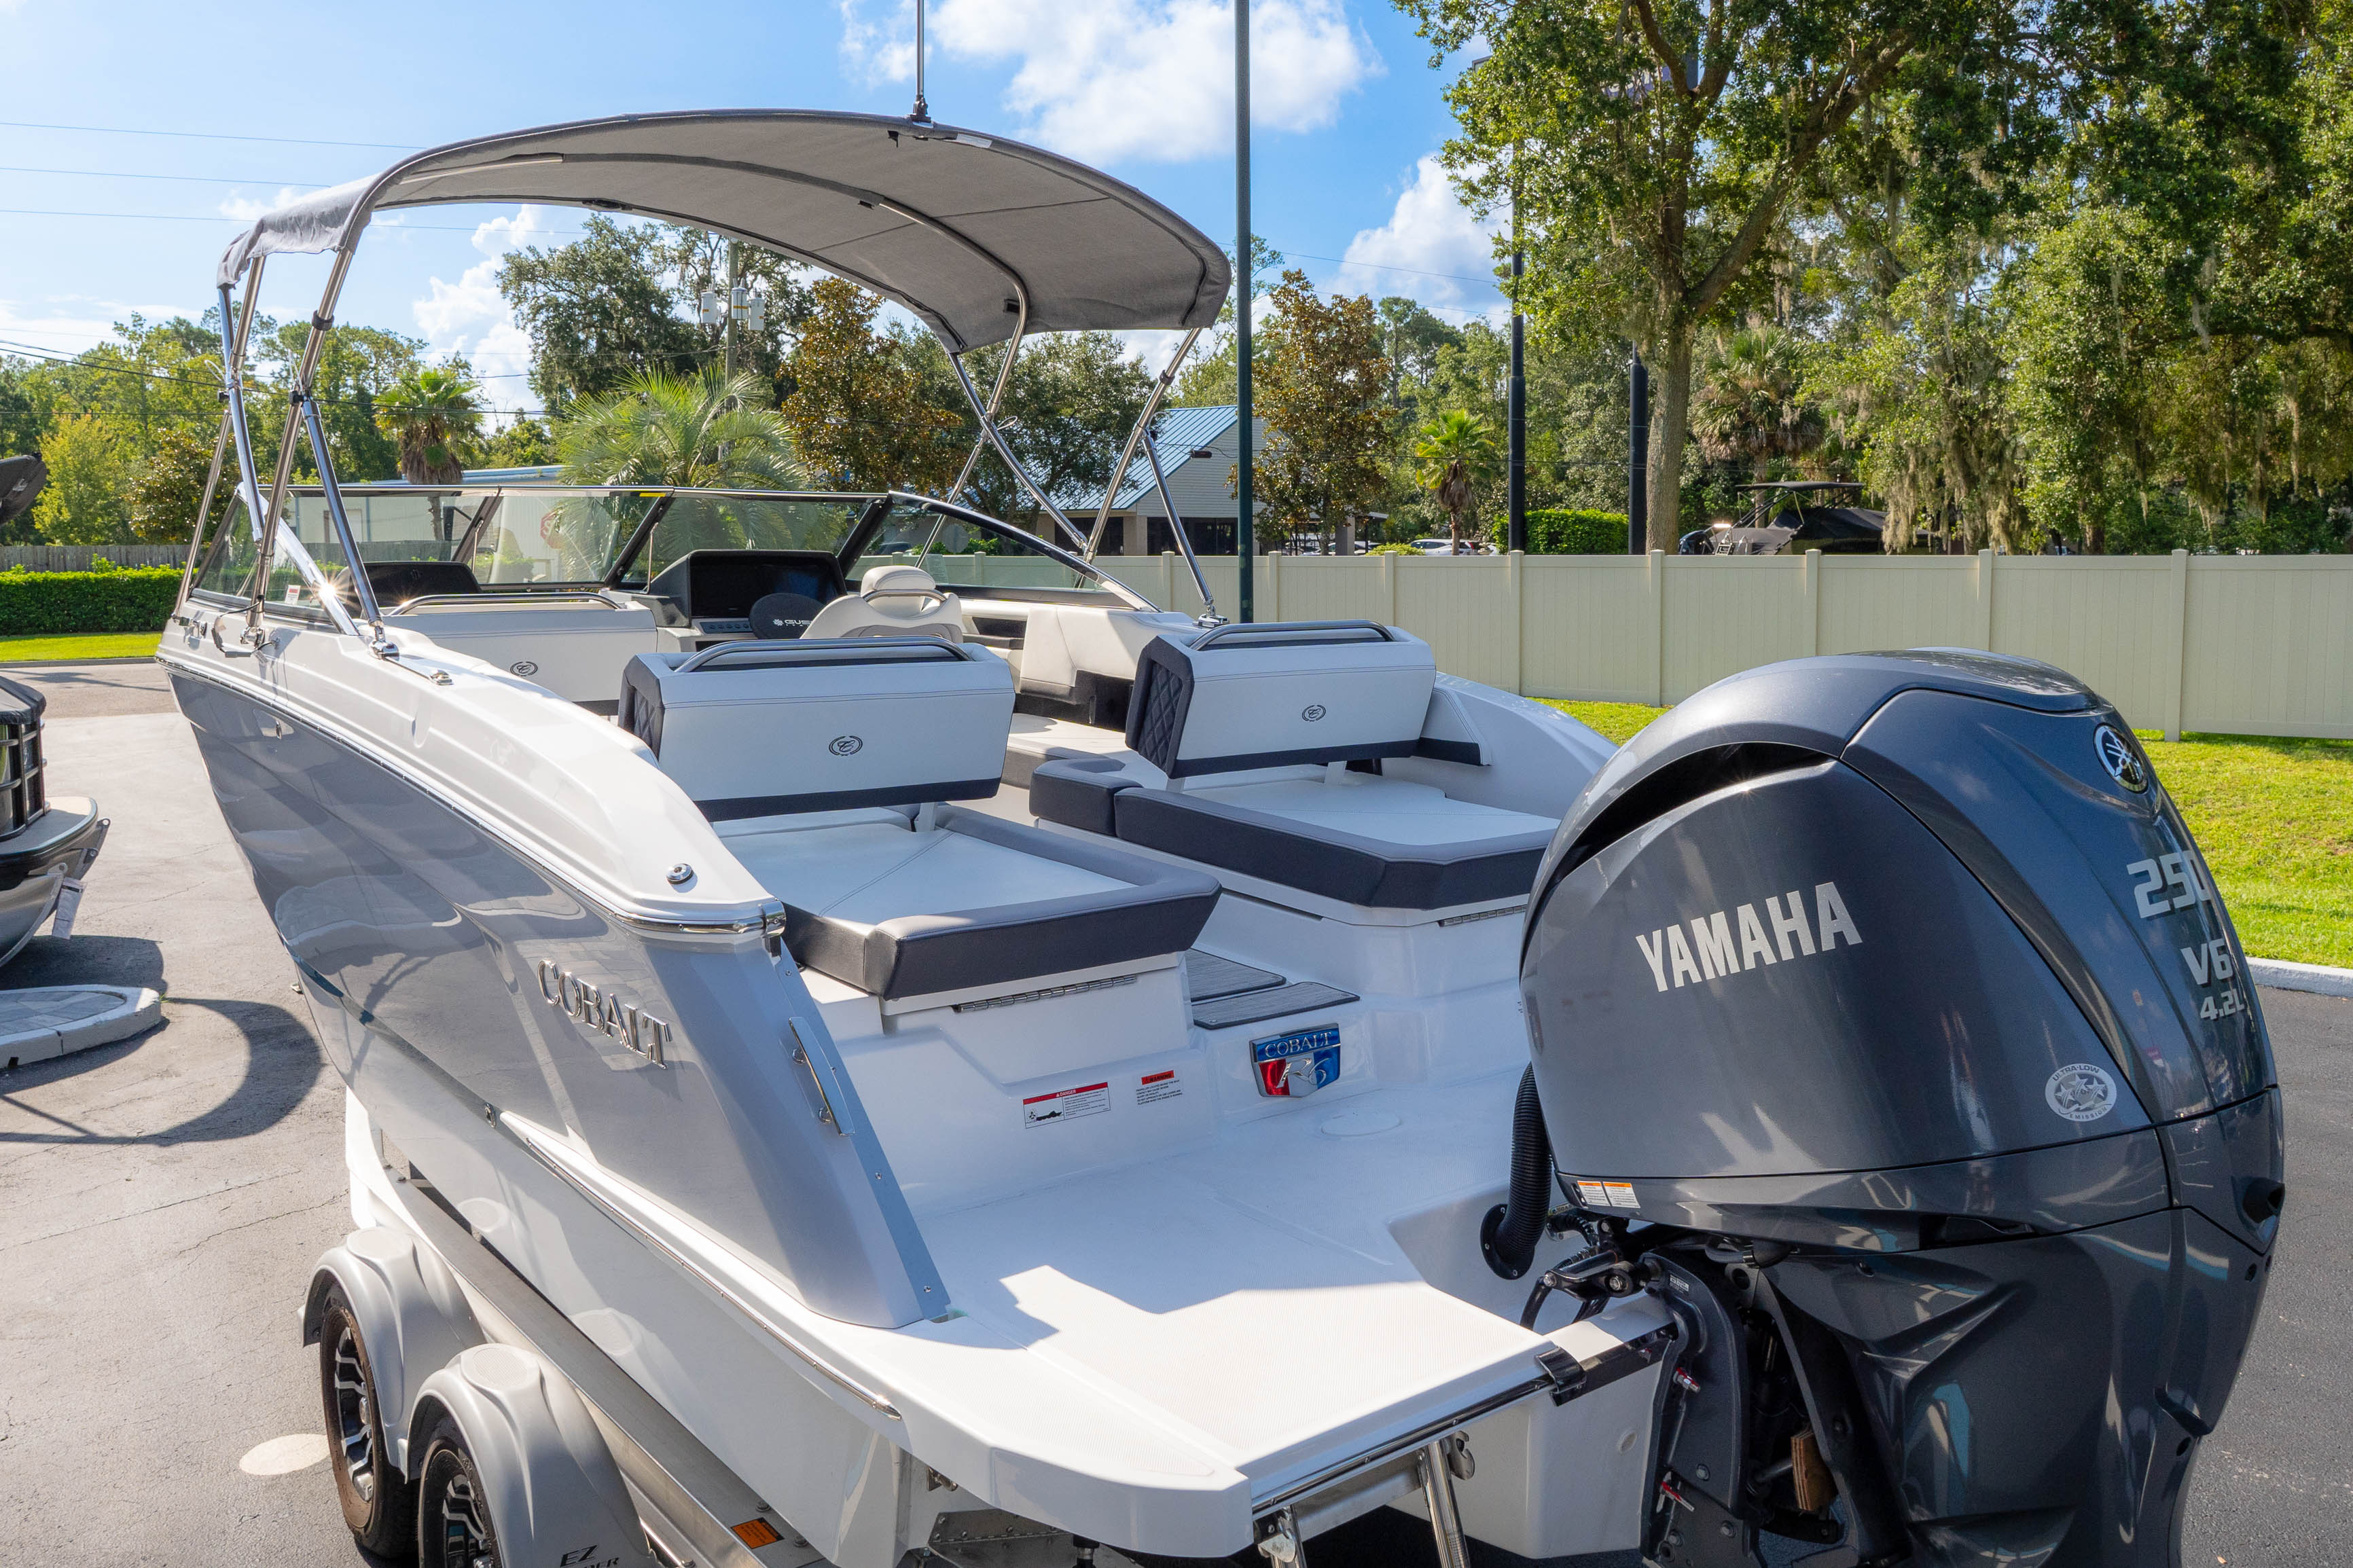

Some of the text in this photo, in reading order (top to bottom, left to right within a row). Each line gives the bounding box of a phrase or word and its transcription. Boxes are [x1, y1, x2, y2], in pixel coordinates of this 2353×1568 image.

[1635, 881, 1863, 992] YAMAHA
[2180, 938, 2233, 985] V6
[537, 960, 672, 1070] COBALT
[2200, 988, 2244, 1020] 4.2L
[1265, 1032, 1331, 1058] COBALT
[560, 1544, 598, 1568] EZ
